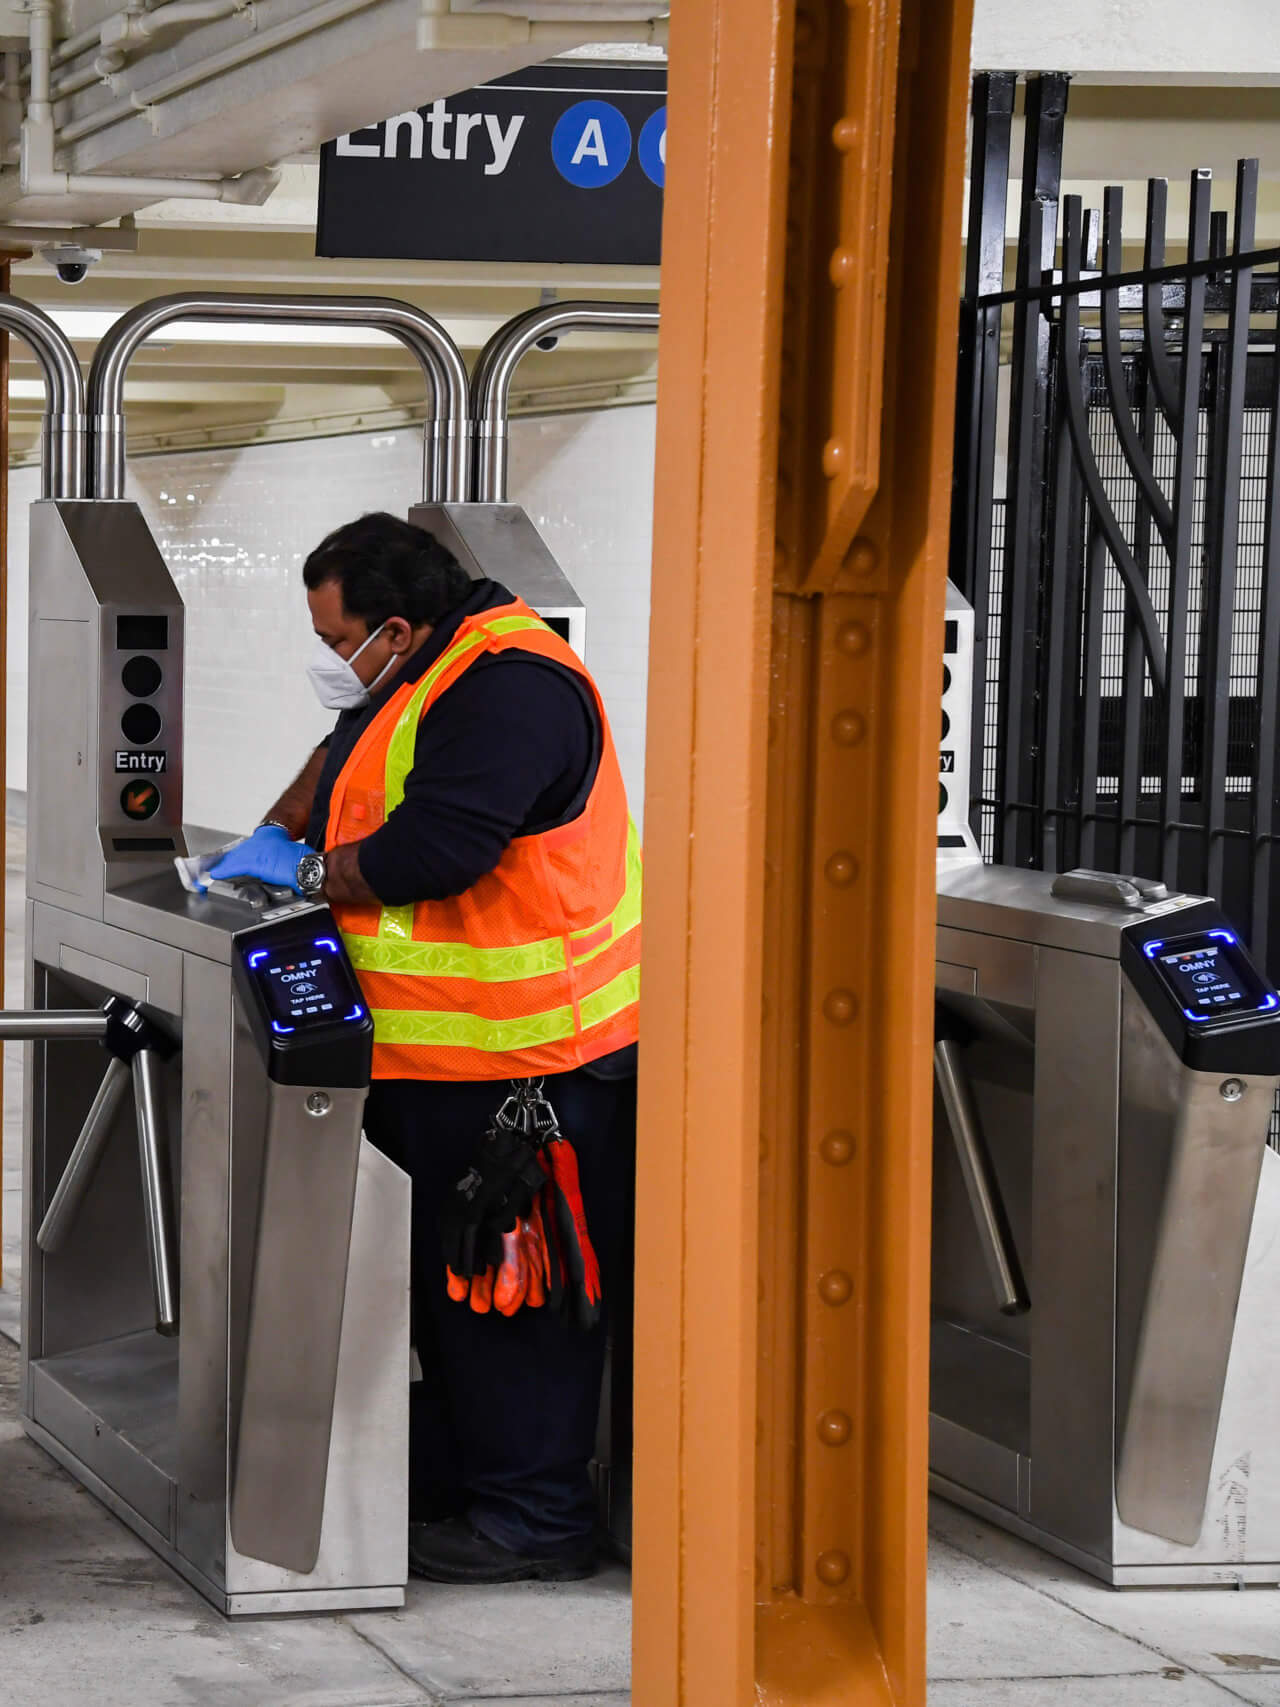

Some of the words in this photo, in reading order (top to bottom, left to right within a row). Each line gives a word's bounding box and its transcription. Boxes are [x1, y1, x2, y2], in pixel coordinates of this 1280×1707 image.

[570, 118, 609, 167] A
[116, 751, 165, 773] Entry
[1179, 959, 1216, 972] OMNY
[280, 969, 317, 983] OMNY
